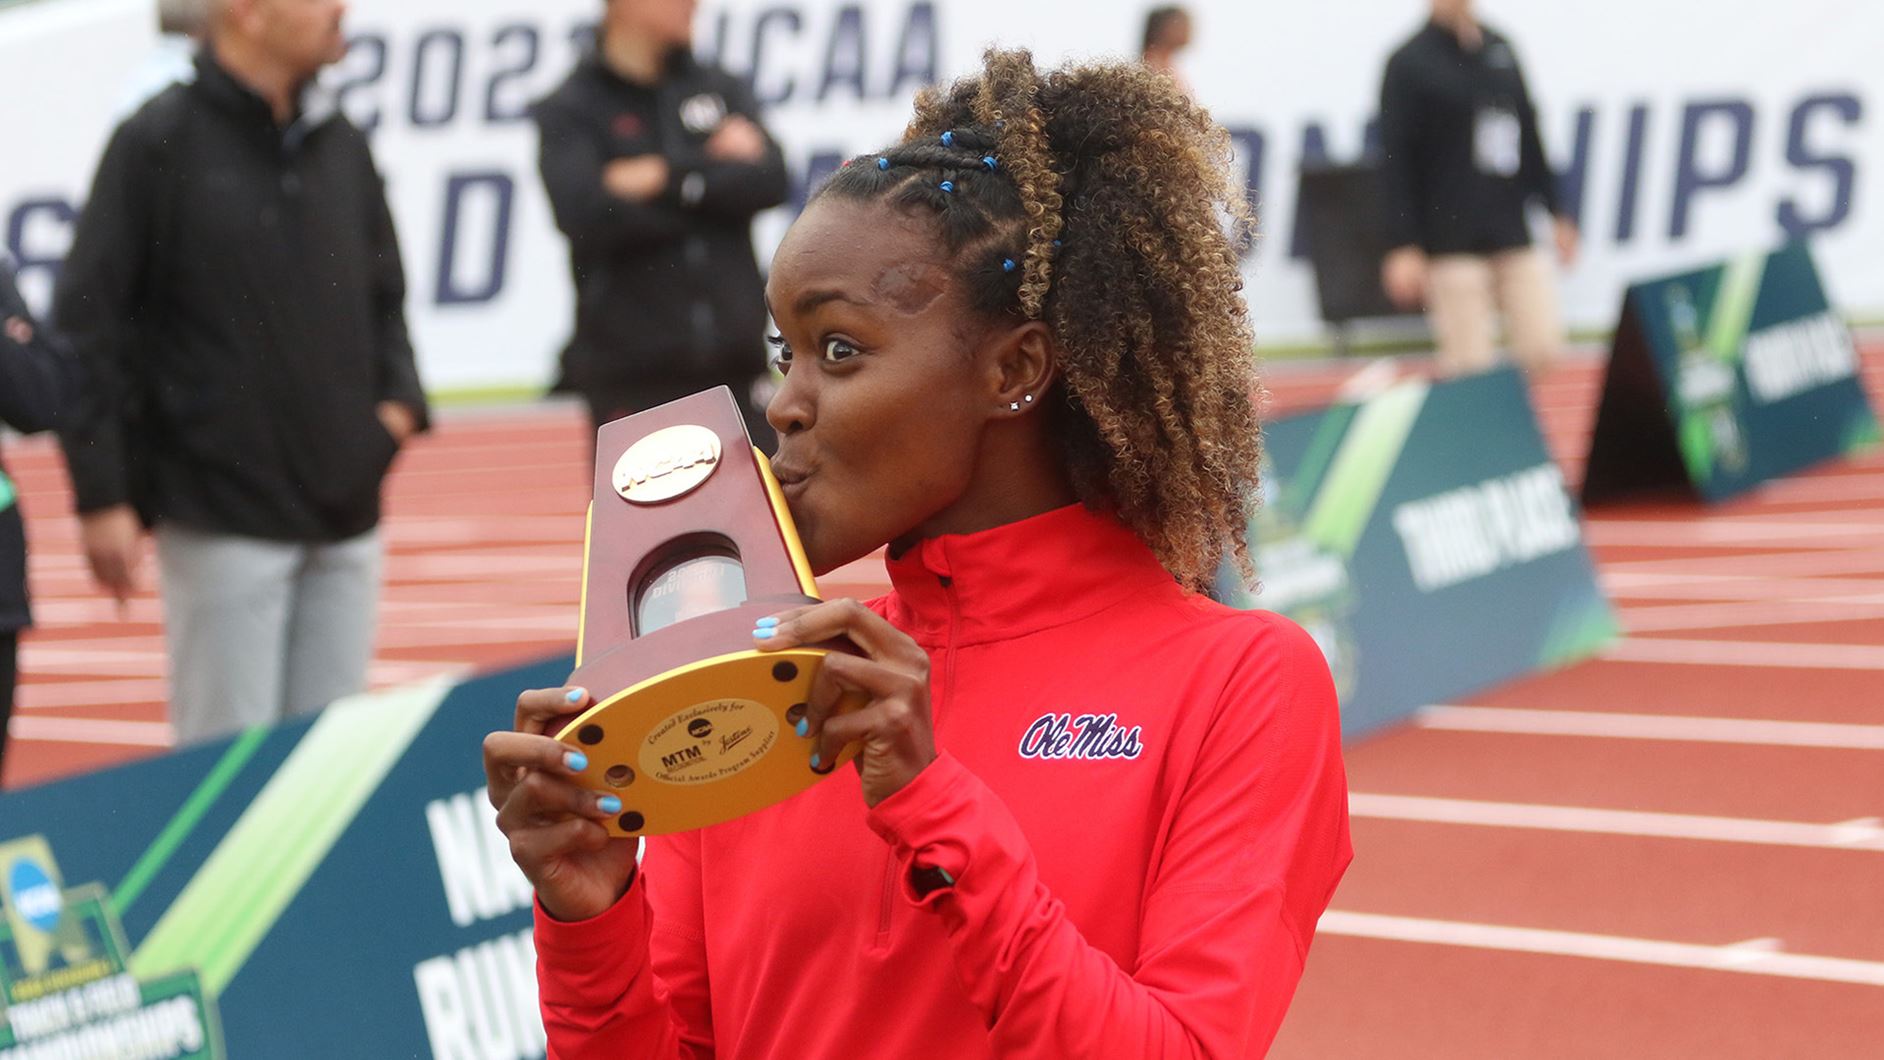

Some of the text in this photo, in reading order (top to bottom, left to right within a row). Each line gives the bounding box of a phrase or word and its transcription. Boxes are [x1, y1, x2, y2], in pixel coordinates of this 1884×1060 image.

[333, 25, 597, 132] 202
[648, 702, 745, 745] Created Exclusively for
[1019, 713, 1143, 759] Ole Miss
[661, 745, 702, 768] MTM
[689, 772, 717, 781] Awards
[719, 758, 750, 775] Program
